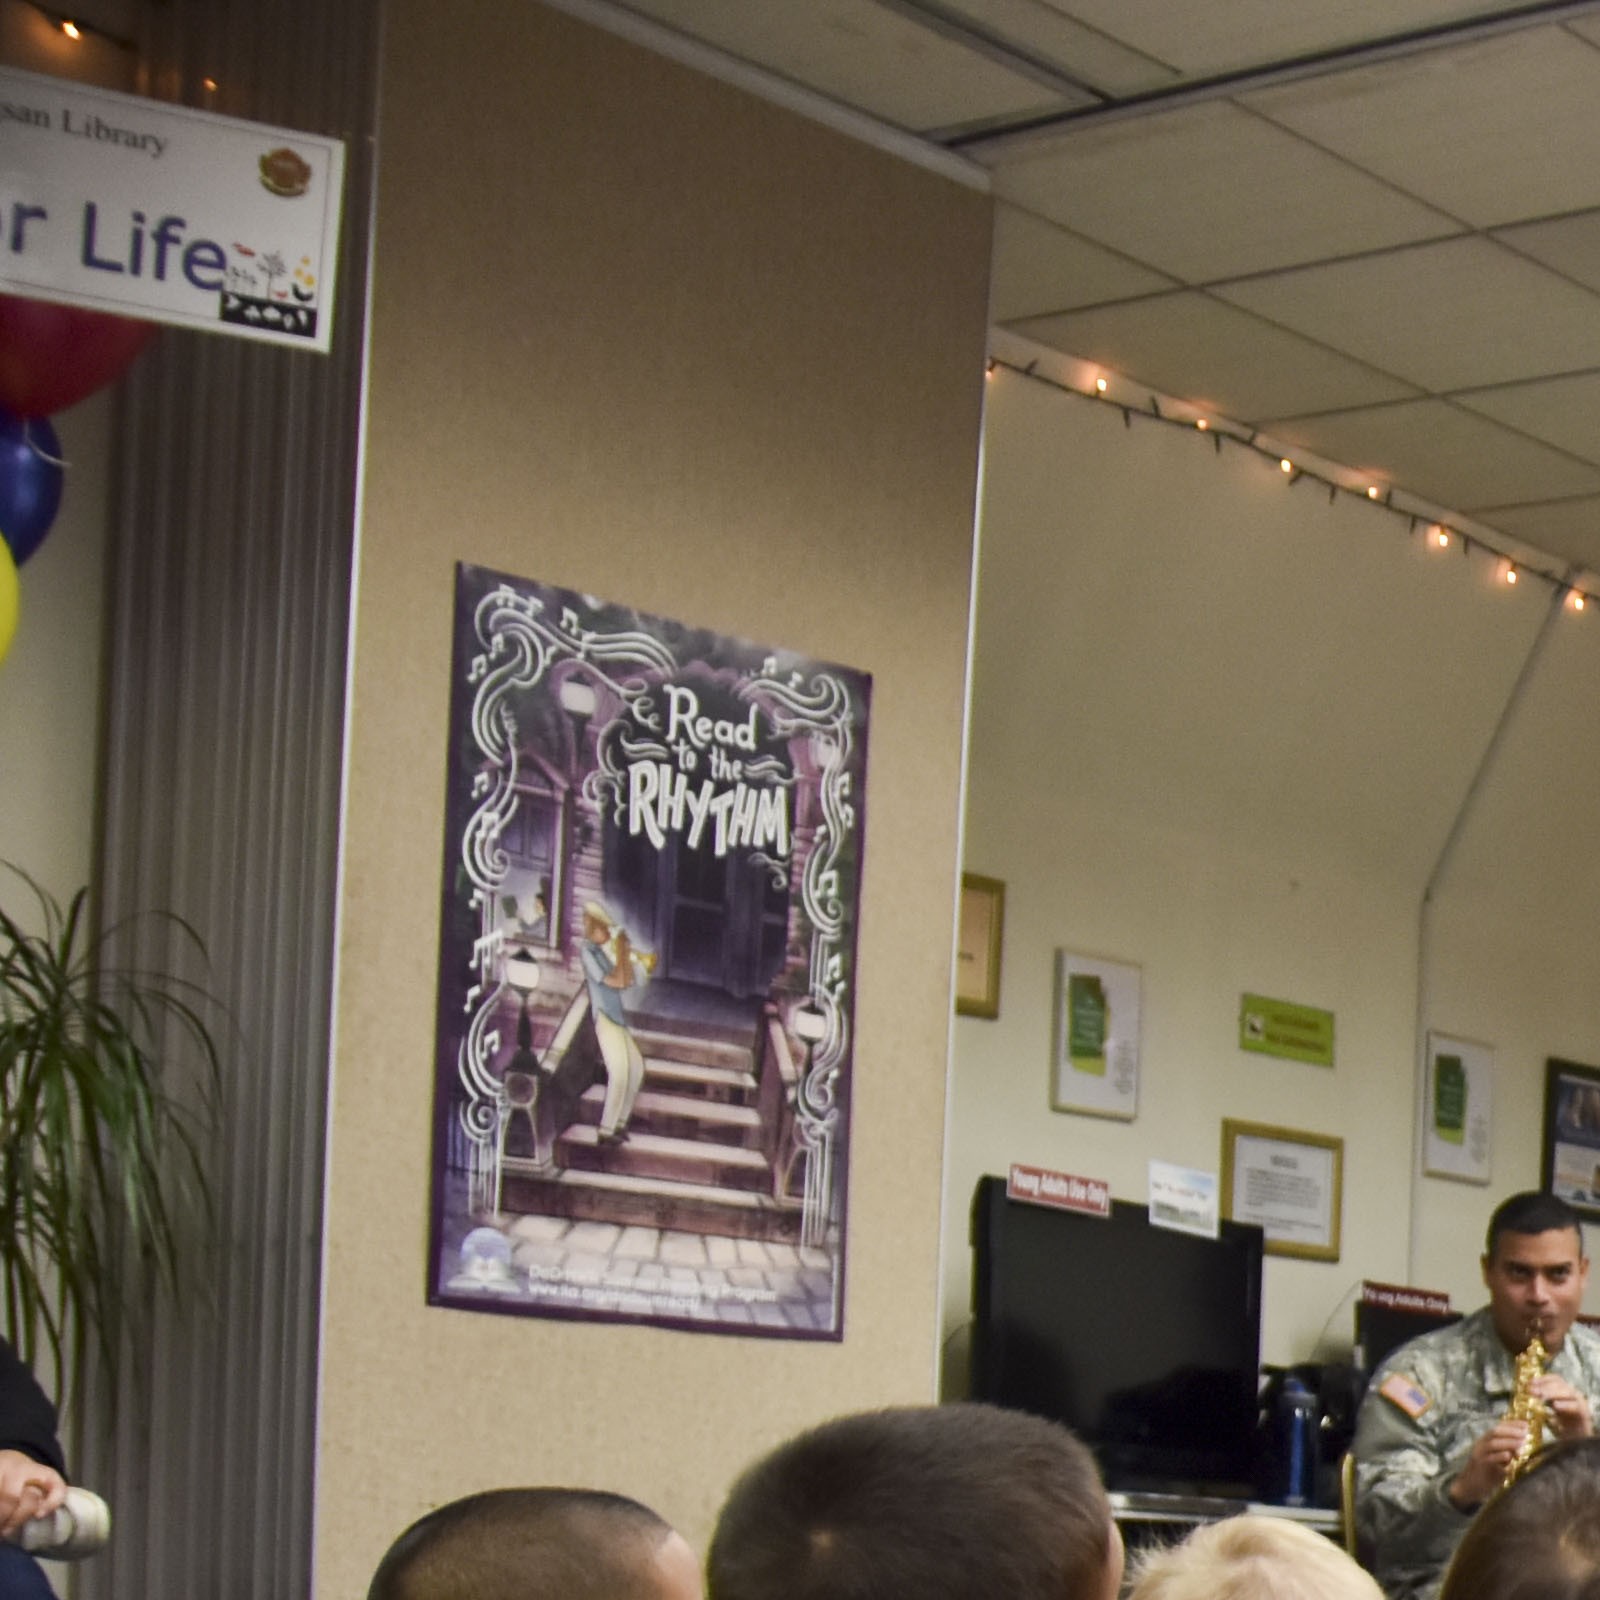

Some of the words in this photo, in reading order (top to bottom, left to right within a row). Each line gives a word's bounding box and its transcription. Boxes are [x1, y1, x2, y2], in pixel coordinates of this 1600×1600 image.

[62, 109, 168, 160] Library
[0, 201, 48, 254] r
[81, 201, 227, 291] Life
[662, 683, 758, 752] Read
[672, 738, 697, 771] to
[708, 744, 743, 781] the
[627, 760, 788, 858] RHYTHM
